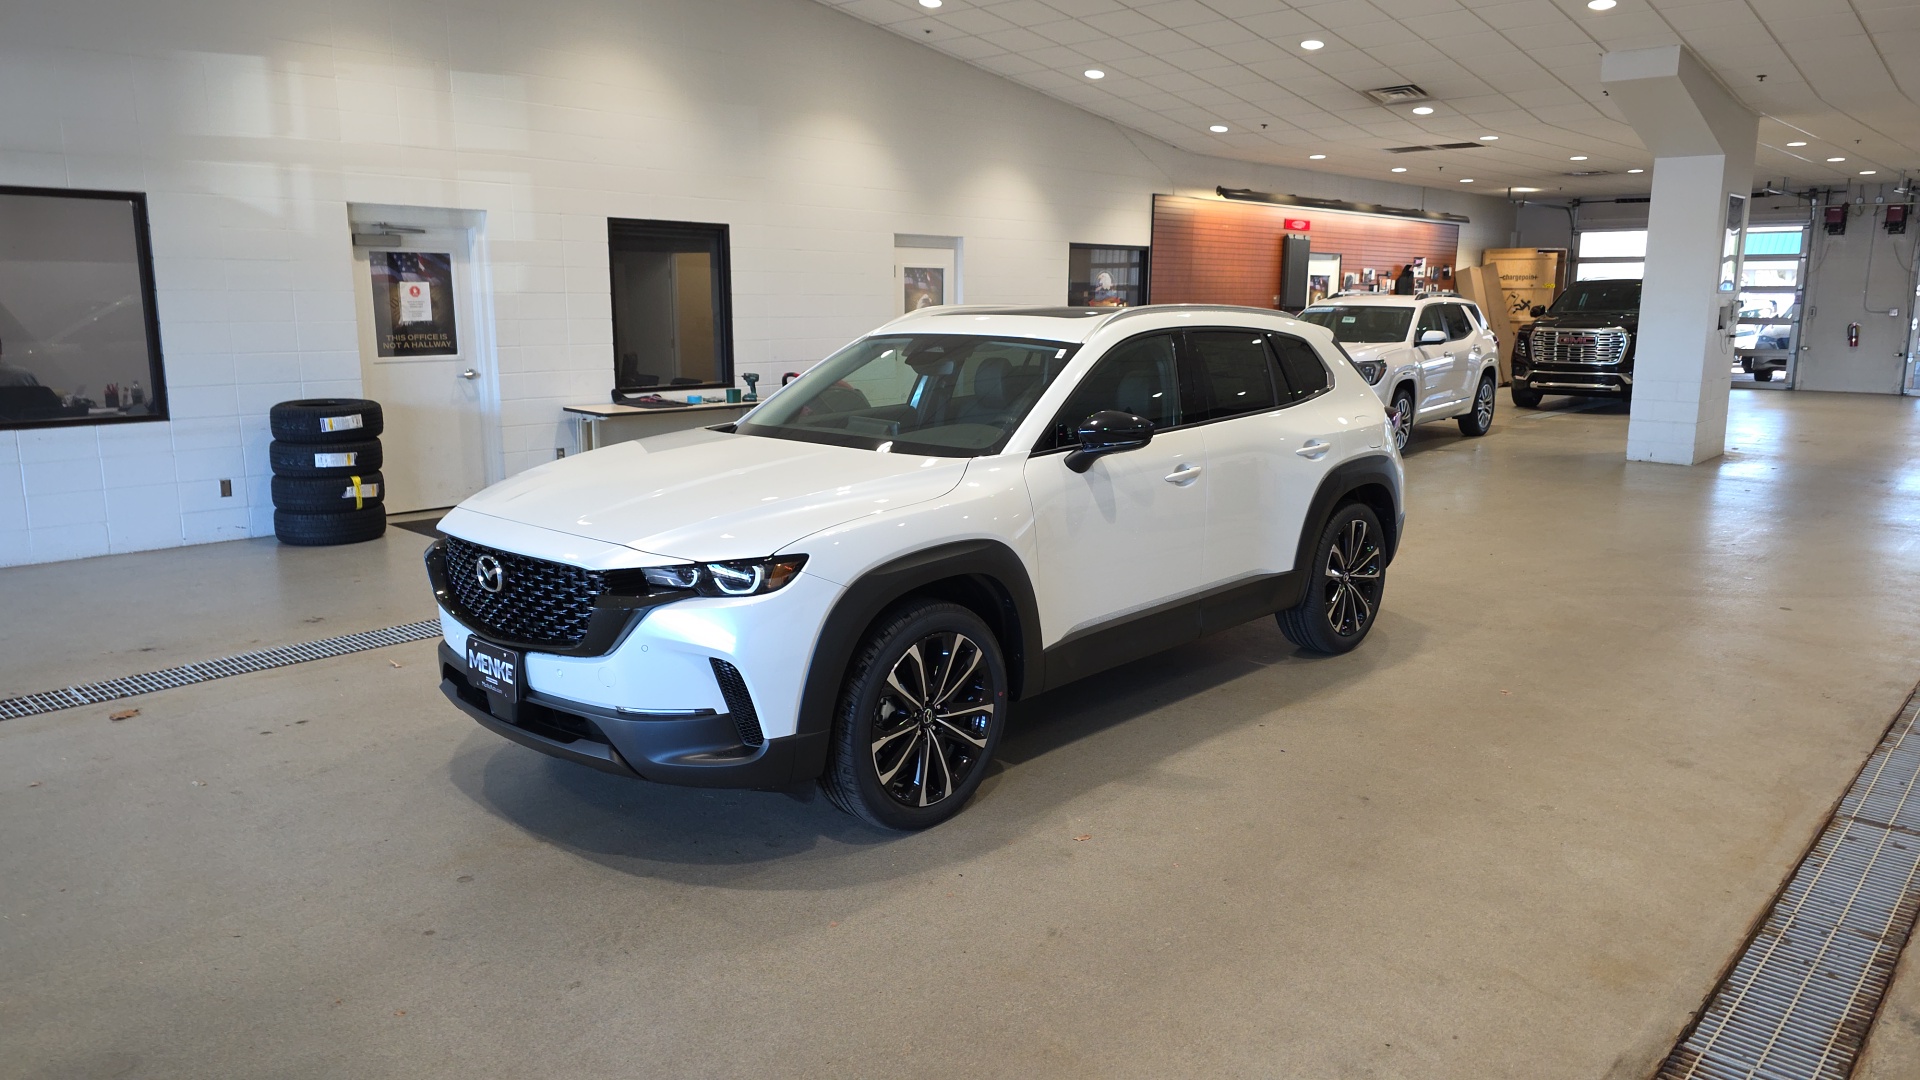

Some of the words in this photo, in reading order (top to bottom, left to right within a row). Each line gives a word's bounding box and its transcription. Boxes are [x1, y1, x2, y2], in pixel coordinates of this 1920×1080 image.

[408, 333, 438, 341] OFFICE
[1559, 336, 1594, 344] GMC
[412, 340, 451, 348] HALLWAY
[468, 649, 513, 685] MENKE
